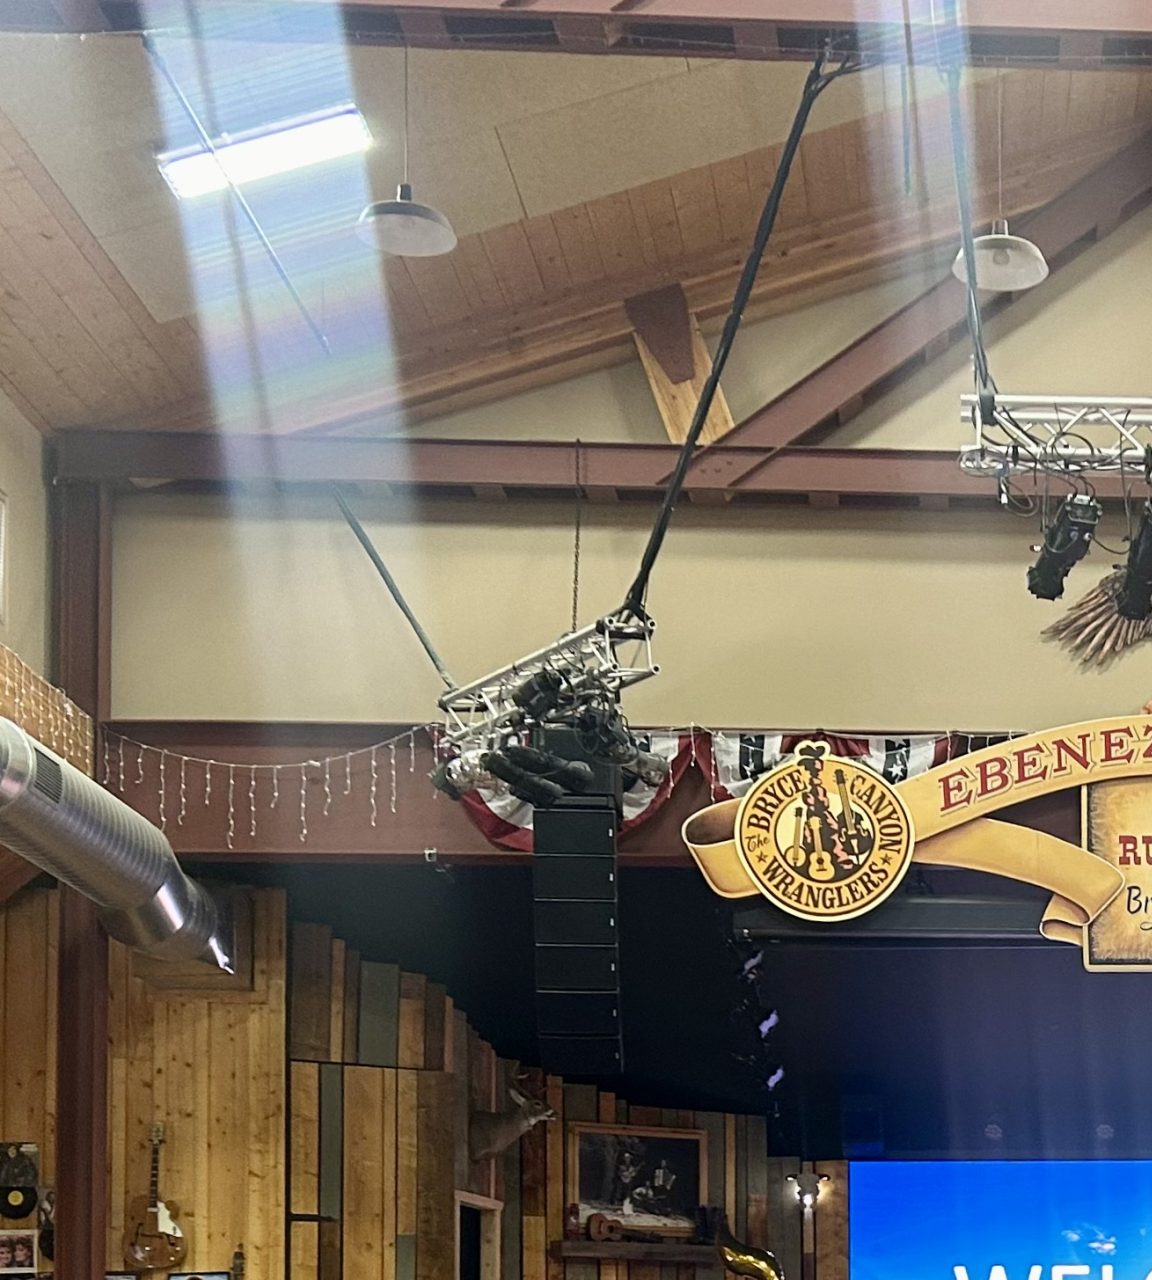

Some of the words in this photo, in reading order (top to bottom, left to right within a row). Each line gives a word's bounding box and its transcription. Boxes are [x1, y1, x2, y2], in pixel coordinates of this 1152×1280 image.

[746, 768, 809, 834] BRYCE
[849, 774, 903, 855] CANYON
[745, 833, 770, 853] The
[762, 855, 890, 910] WRANGLERS
